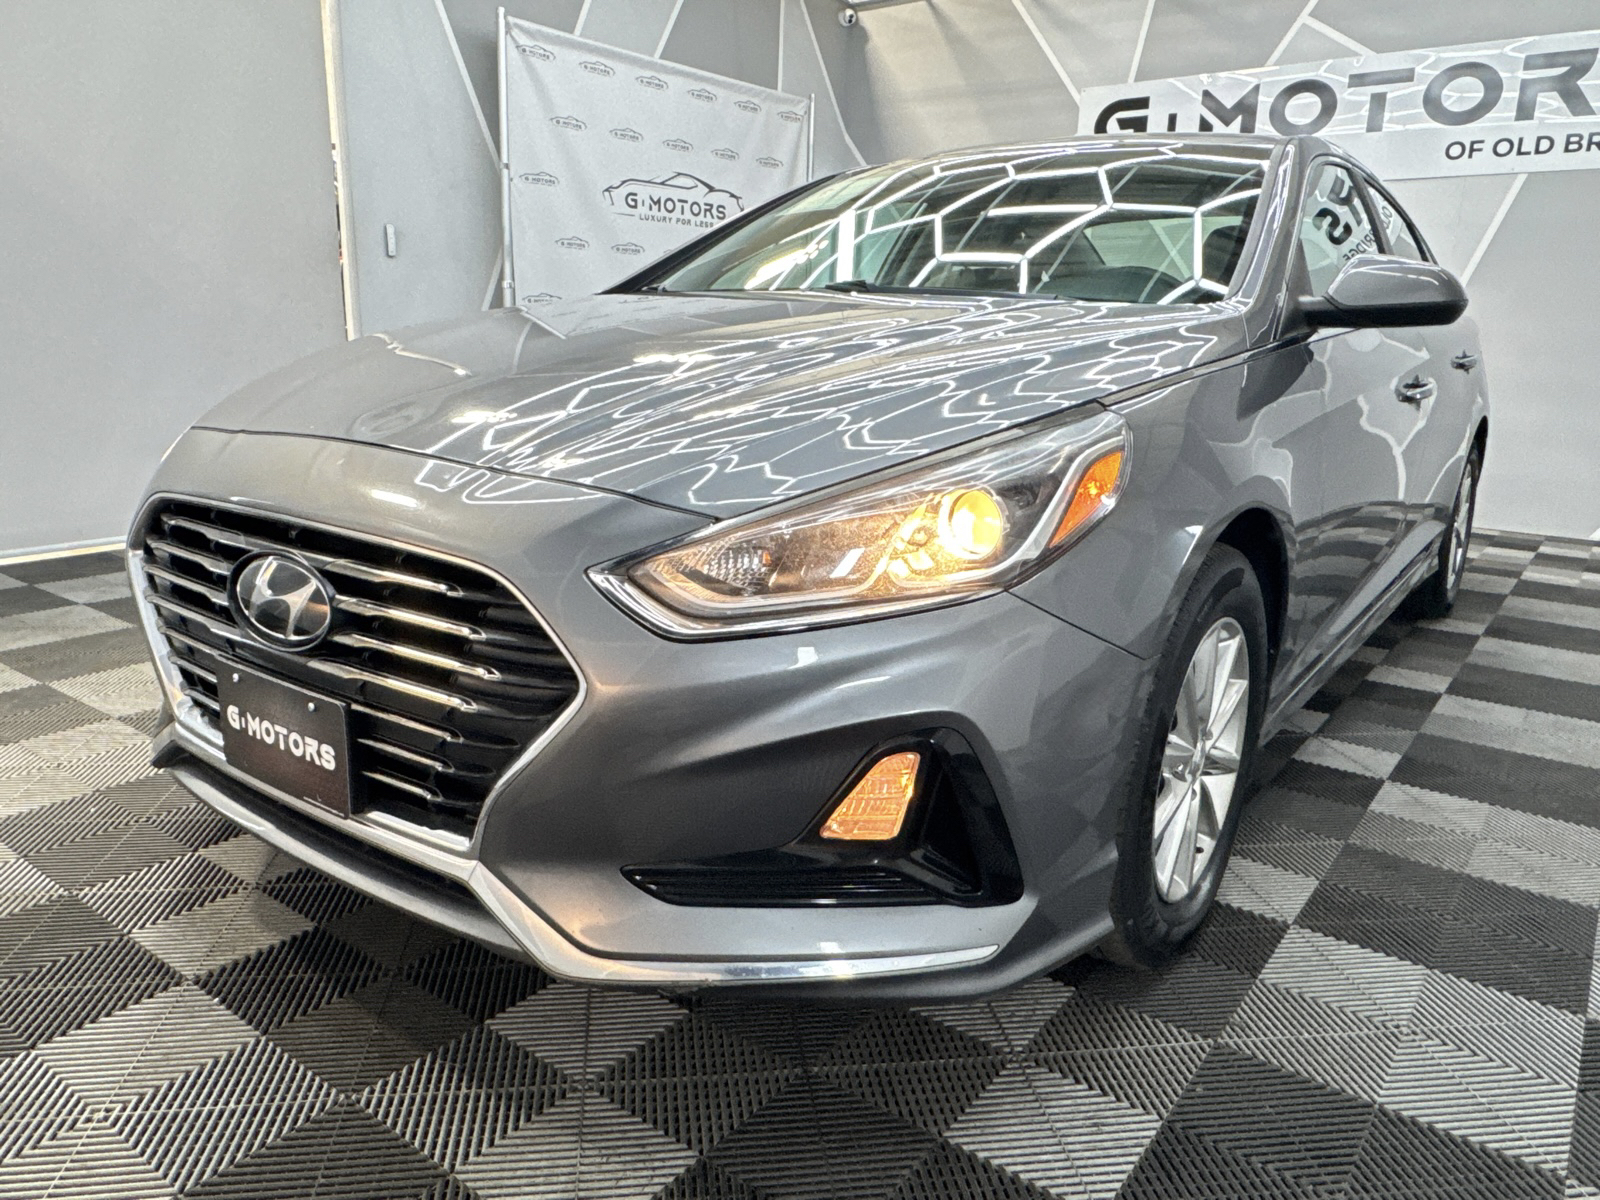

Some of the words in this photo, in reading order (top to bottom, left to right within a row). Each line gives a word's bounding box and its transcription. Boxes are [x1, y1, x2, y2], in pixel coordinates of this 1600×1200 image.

[1445, 140, 1485, 160] OF
[1492, 135, 1555, 158] OLD
[639, 213, 673, 224] LUXURY
[676, 217, 692, 226] FOR
